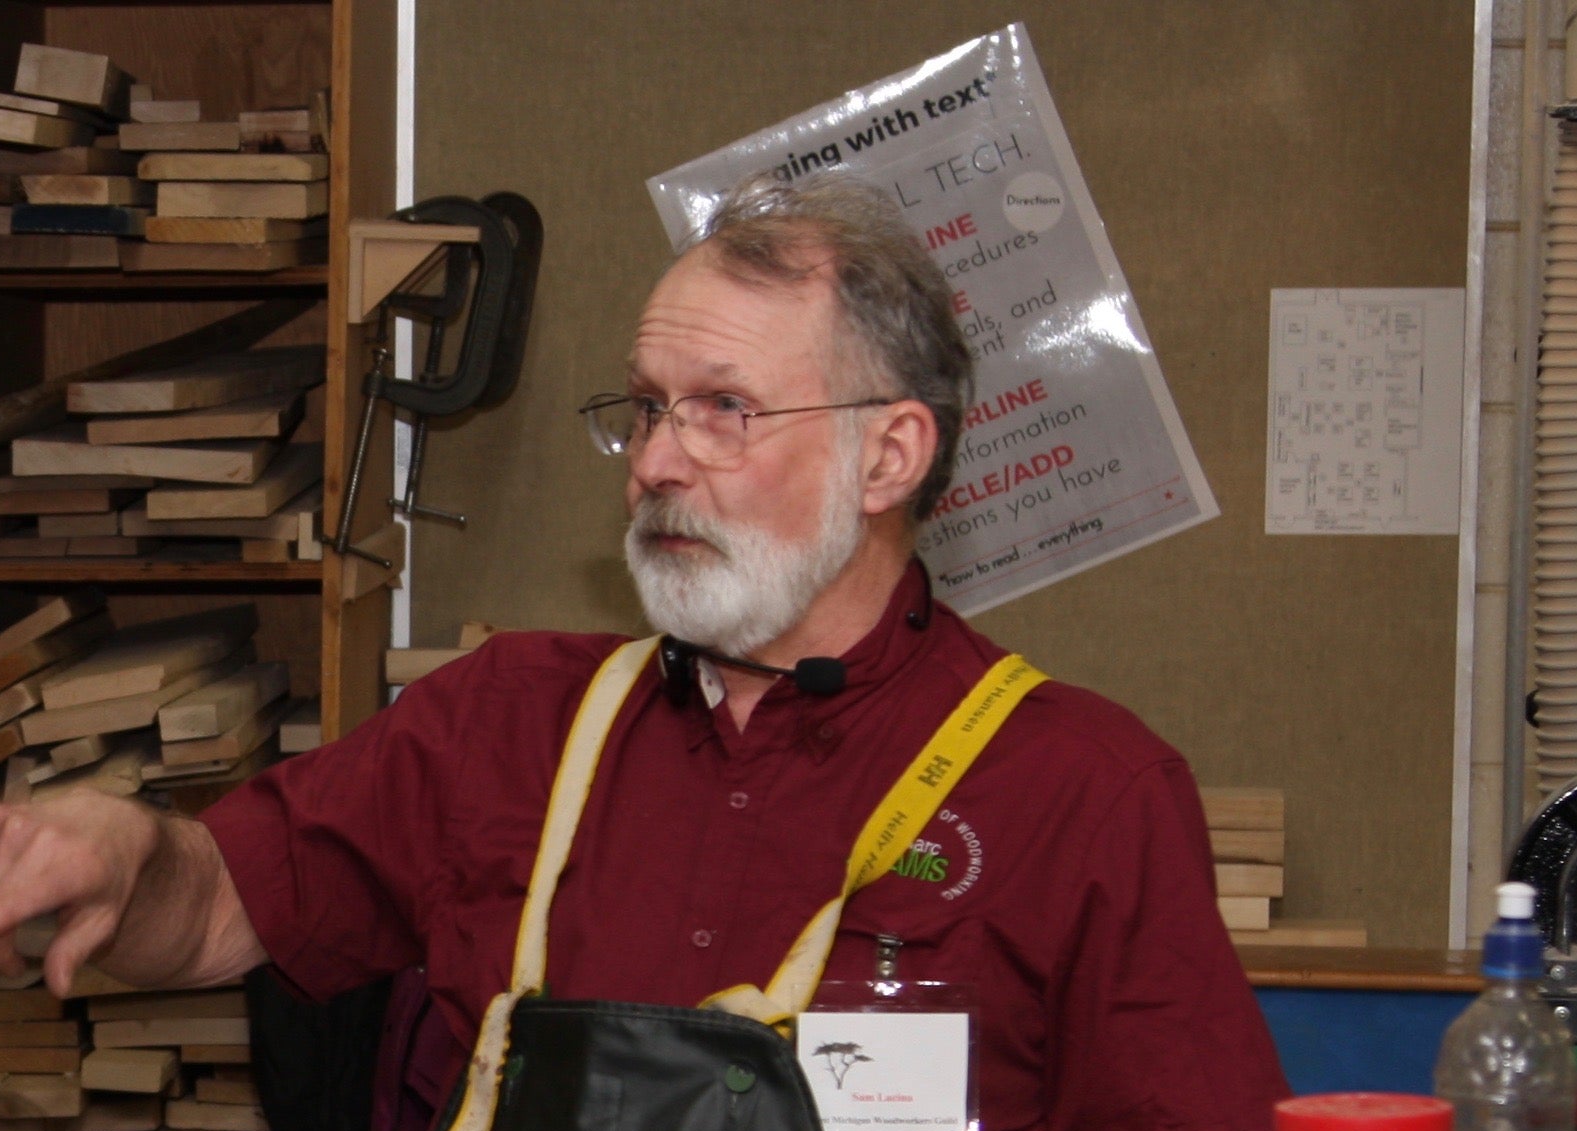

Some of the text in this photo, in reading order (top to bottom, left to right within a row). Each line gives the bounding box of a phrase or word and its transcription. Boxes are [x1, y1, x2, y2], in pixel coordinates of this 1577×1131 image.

[773, 142, 842, 184] ging
[844, 109, 920, 153] with
[926, 134, 1031, 191] TECH.
[1007, 194, 1061, 206] Directions
[923, 213, 978, 251] INE
[945, 231, 1040, 278] cedures
[963, 310, 1002, 337] als,
[1010, 279, 1058, 319] and
[964, 378, 1049, 430] RLINE
[954, 403, 1088, 468] nformation
[919, 457, 1122, 550] estions you have
[931, 444, 1075, 520] RCLE/ADD
[976, 562, 990, 575] to
[962, 687, 1007, 733] Hansen
[876, 811, 908, 851] Helly
[910, 838, 943, 856] arc
[938, 809, 984, 901] OF WOODWORKING
[892, 851, 950, 882] AMS
